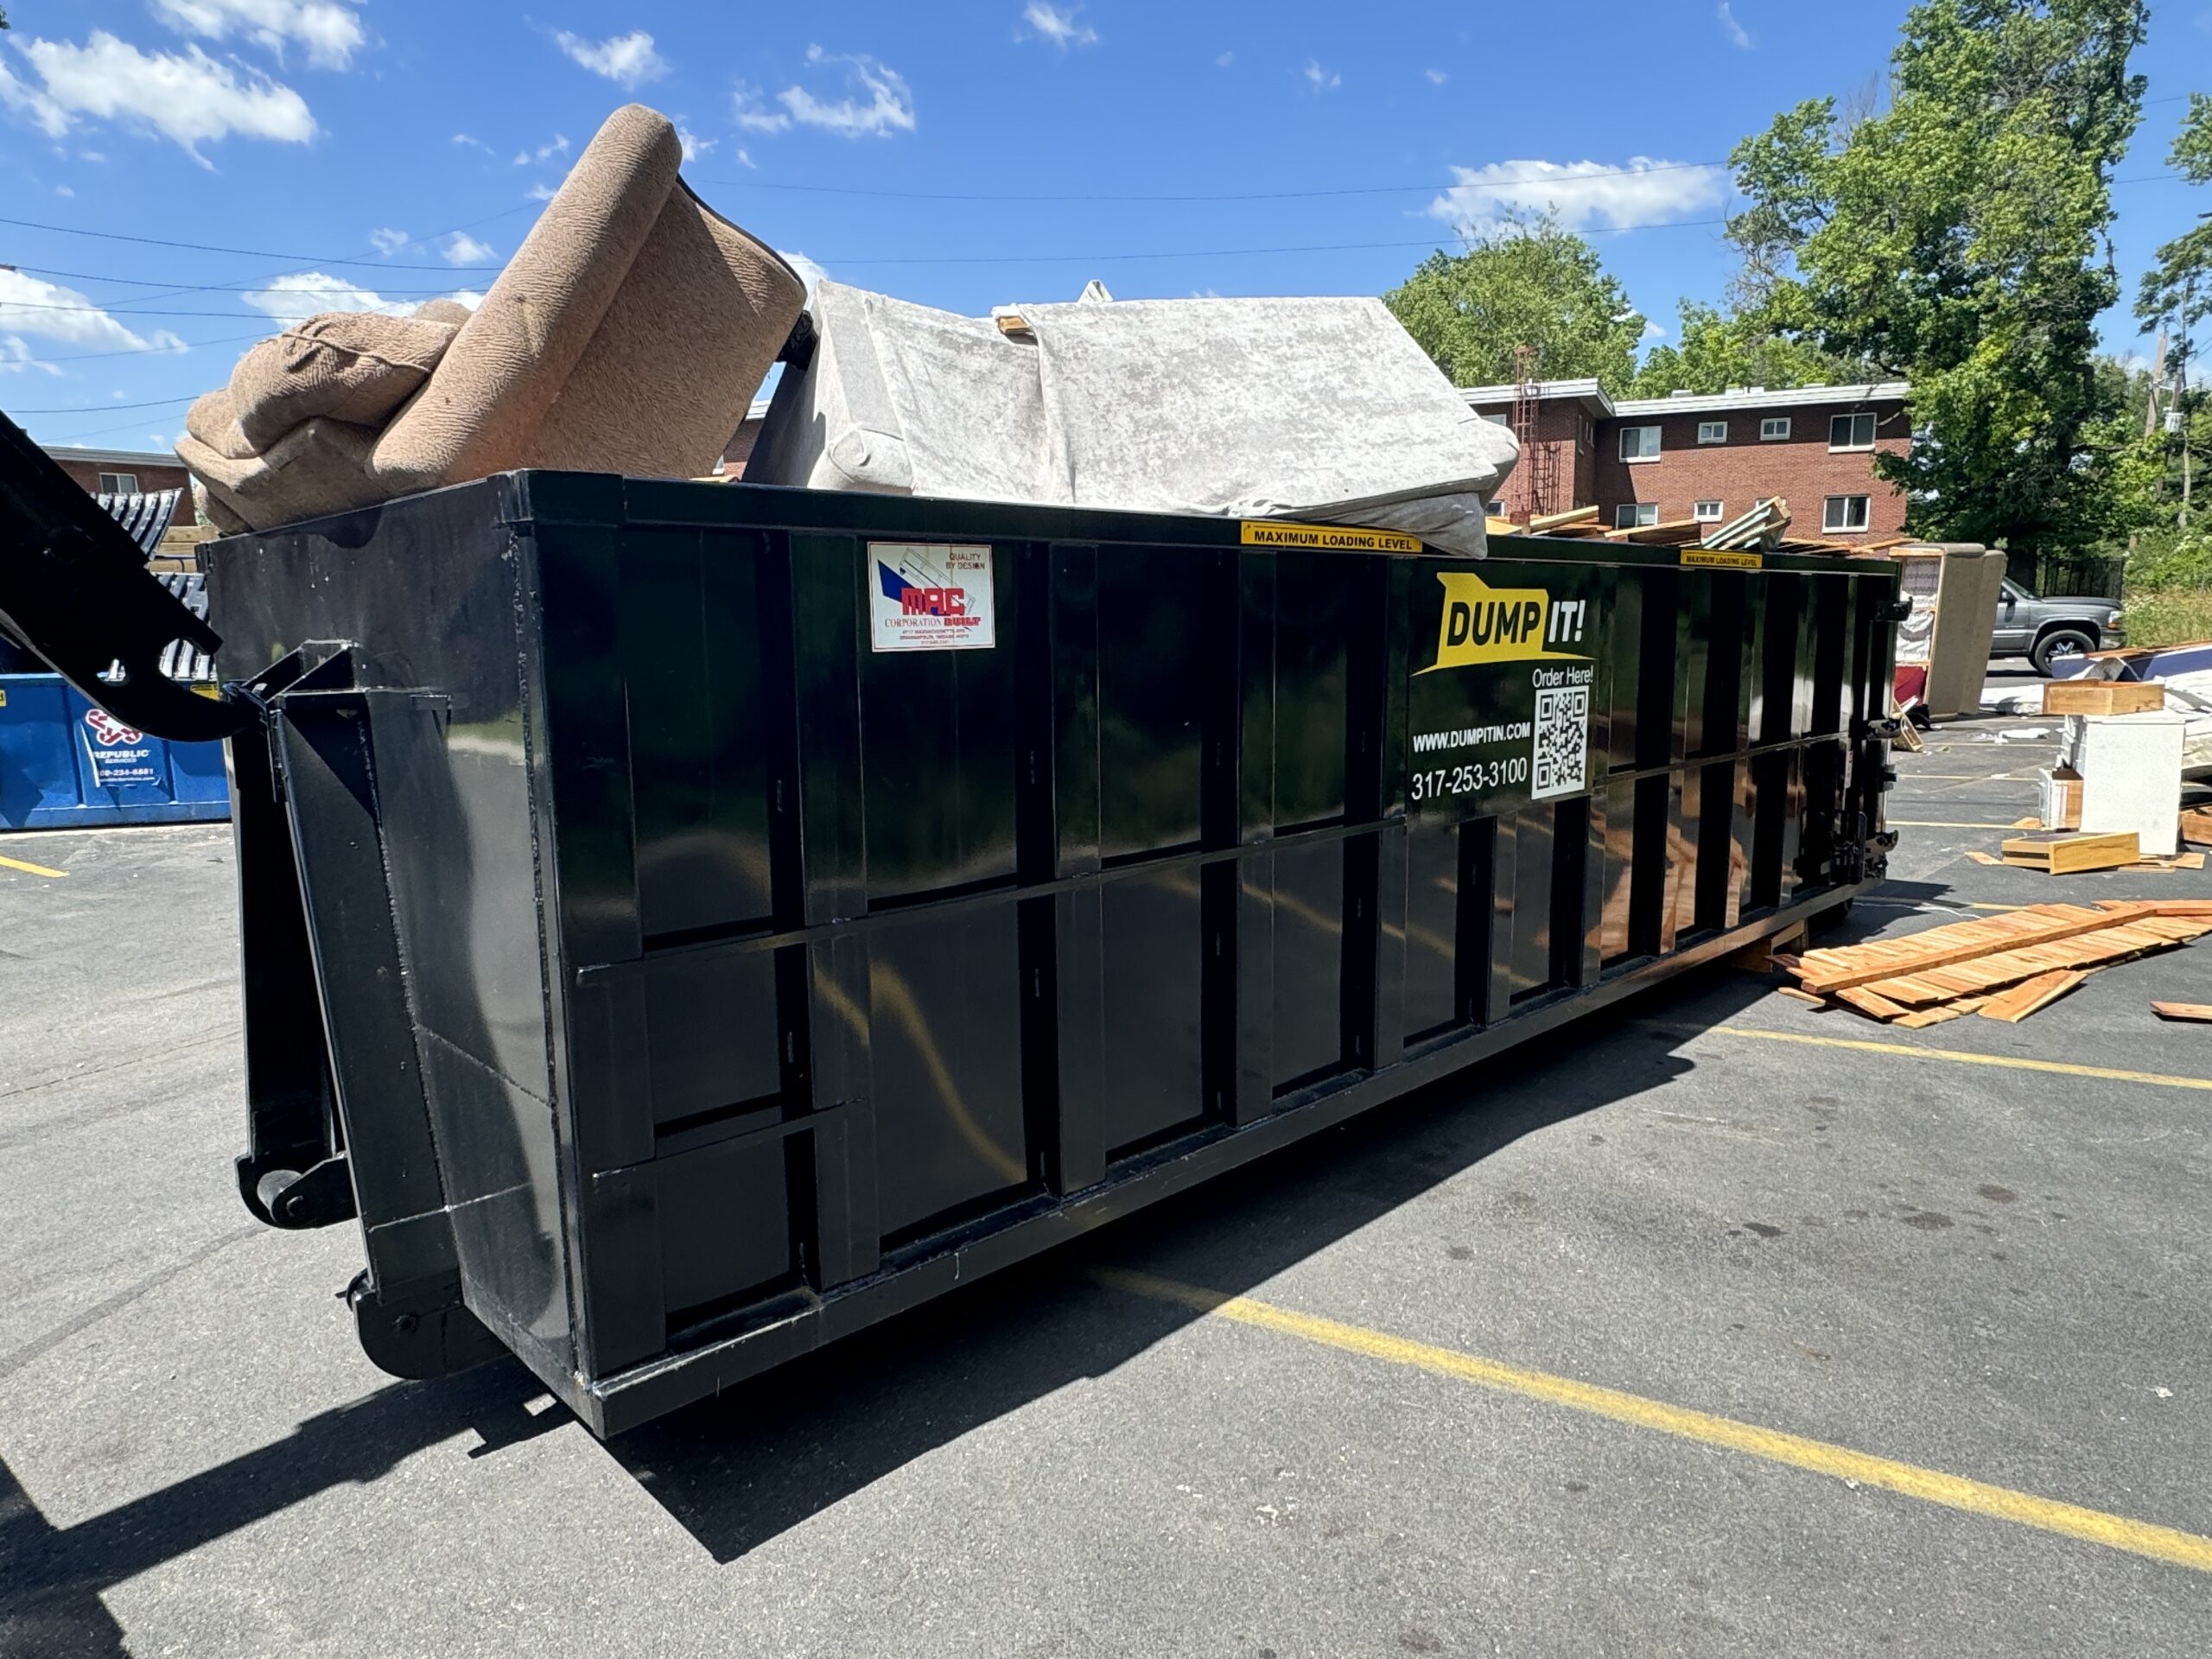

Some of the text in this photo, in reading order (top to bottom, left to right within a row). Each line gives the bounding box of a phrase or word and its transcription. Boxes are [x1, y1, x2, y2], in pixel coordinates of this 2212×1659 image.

[1254, 531, 1413, 550] MAXIMUM LOADING LEVEL
[1686, 555, 1714, 563] MAXIMUM
[1741, 558, 1757, 567] LEVEL
[900, 588, 966, 616] MAC
[885, 616, 982, 628] CORPORATION BUILT
[1446, 600, 1586, 647] DUMP IT!
[1532, 665, 1593, 688] Order Here!
[1413, 721, 1531, 753] WWW.DUMPITIN.COM
[92, 749, 150, 759] REPUBLIC
[1411, 757, 1528, 800] 317-253-3100
